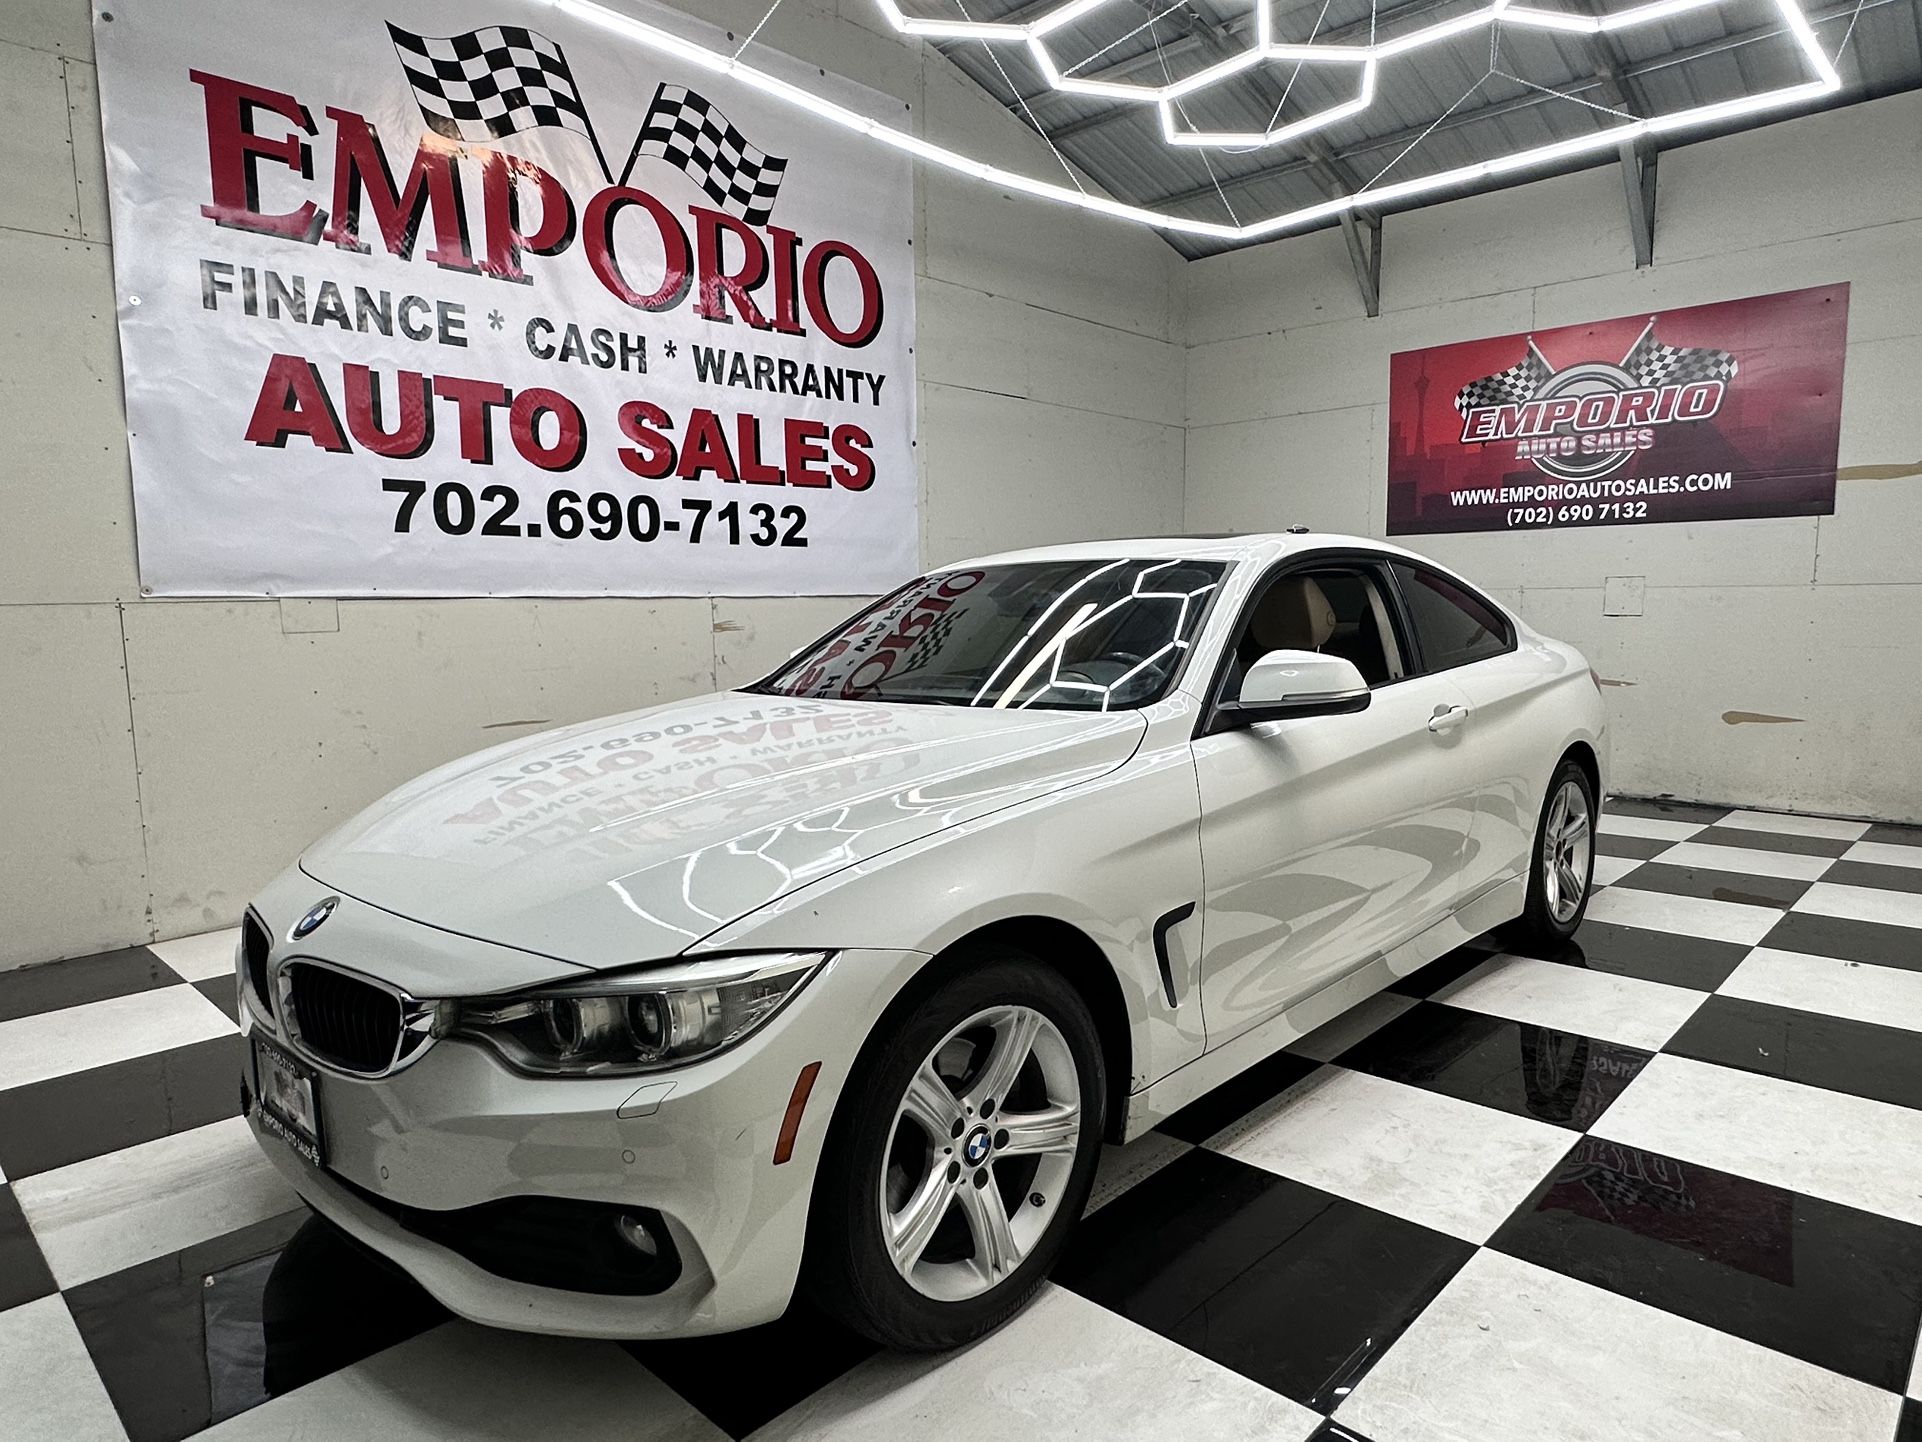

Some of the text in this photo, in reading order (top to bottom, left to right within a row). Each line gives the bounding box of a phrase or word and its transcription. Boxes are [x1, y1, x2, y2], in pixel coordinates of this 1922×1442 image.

[189, 68, 884, 349] EMPORIO
[200, 259, 886, 406] FINANCE CASH WARRANTY
[245, 353, 876, 492] AUTO SALES
[1461, 380, 1725, 442] EMPORIO
[1515, 428, 1655, 460] AUTO SALES
[381, 479, 809, 548] 702.690-7132
[1450, 472, 1733, 507] WWW.EMPORIOAUTOSALES.COM
[1506, 502, 1647, 526] (702) 690 7132
